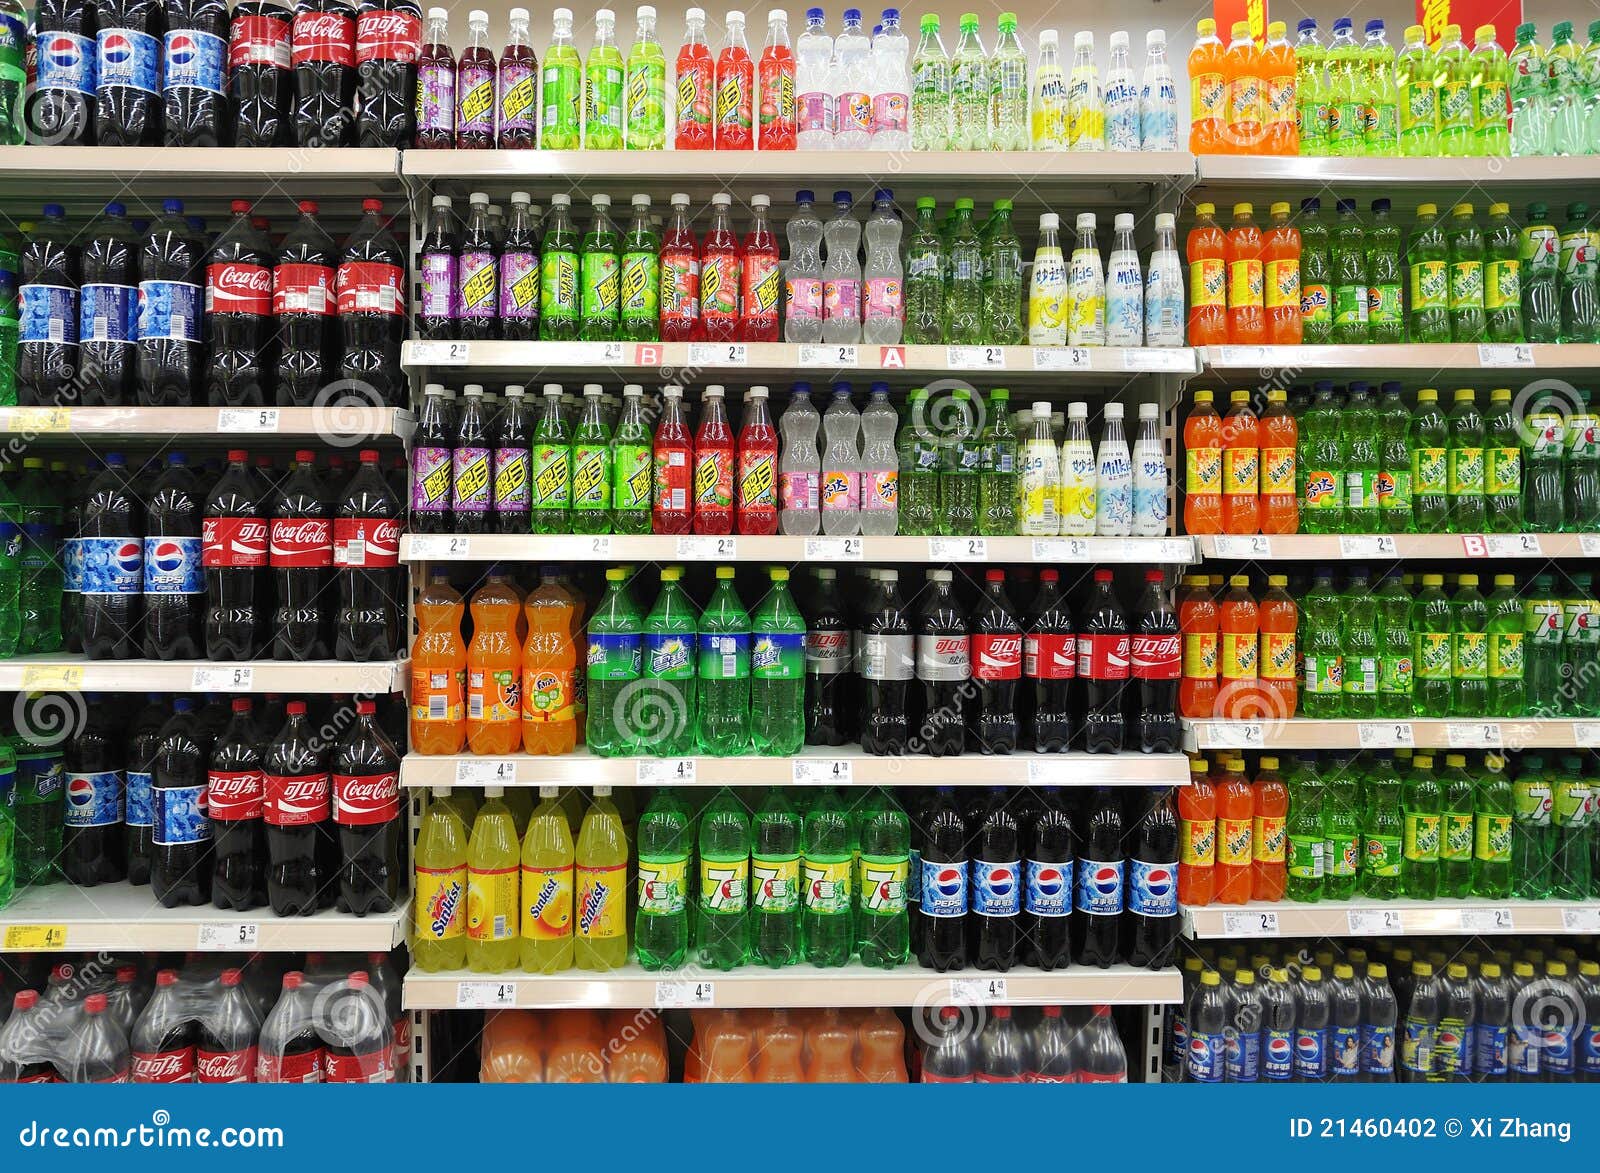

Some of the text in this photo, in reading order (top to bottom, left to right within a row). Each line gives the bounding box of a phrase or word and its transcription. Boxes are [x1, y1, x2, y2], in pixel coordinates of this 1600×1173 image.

[1041, 80, 1066, 97] Milk
[1105, 85, 1138, 104] Milkis
[1117, 269, 1142, 284] Milk
[642, 348, 657, 364] B
[882, 349, 903, 367] A
[239, 524, 269, 543] 可口
[273, 522, 328, 543] Coca-Cola
[1464, 537, 1485, 555] B
[152, 576, 185, 584] PEPSI
[284, 781, 329, 802] 可口可
[530, 877, 559, 920] Sunkist
[580, 880, 607, 935] Sunkist
[431, 880, 462, 938] Sunkist
